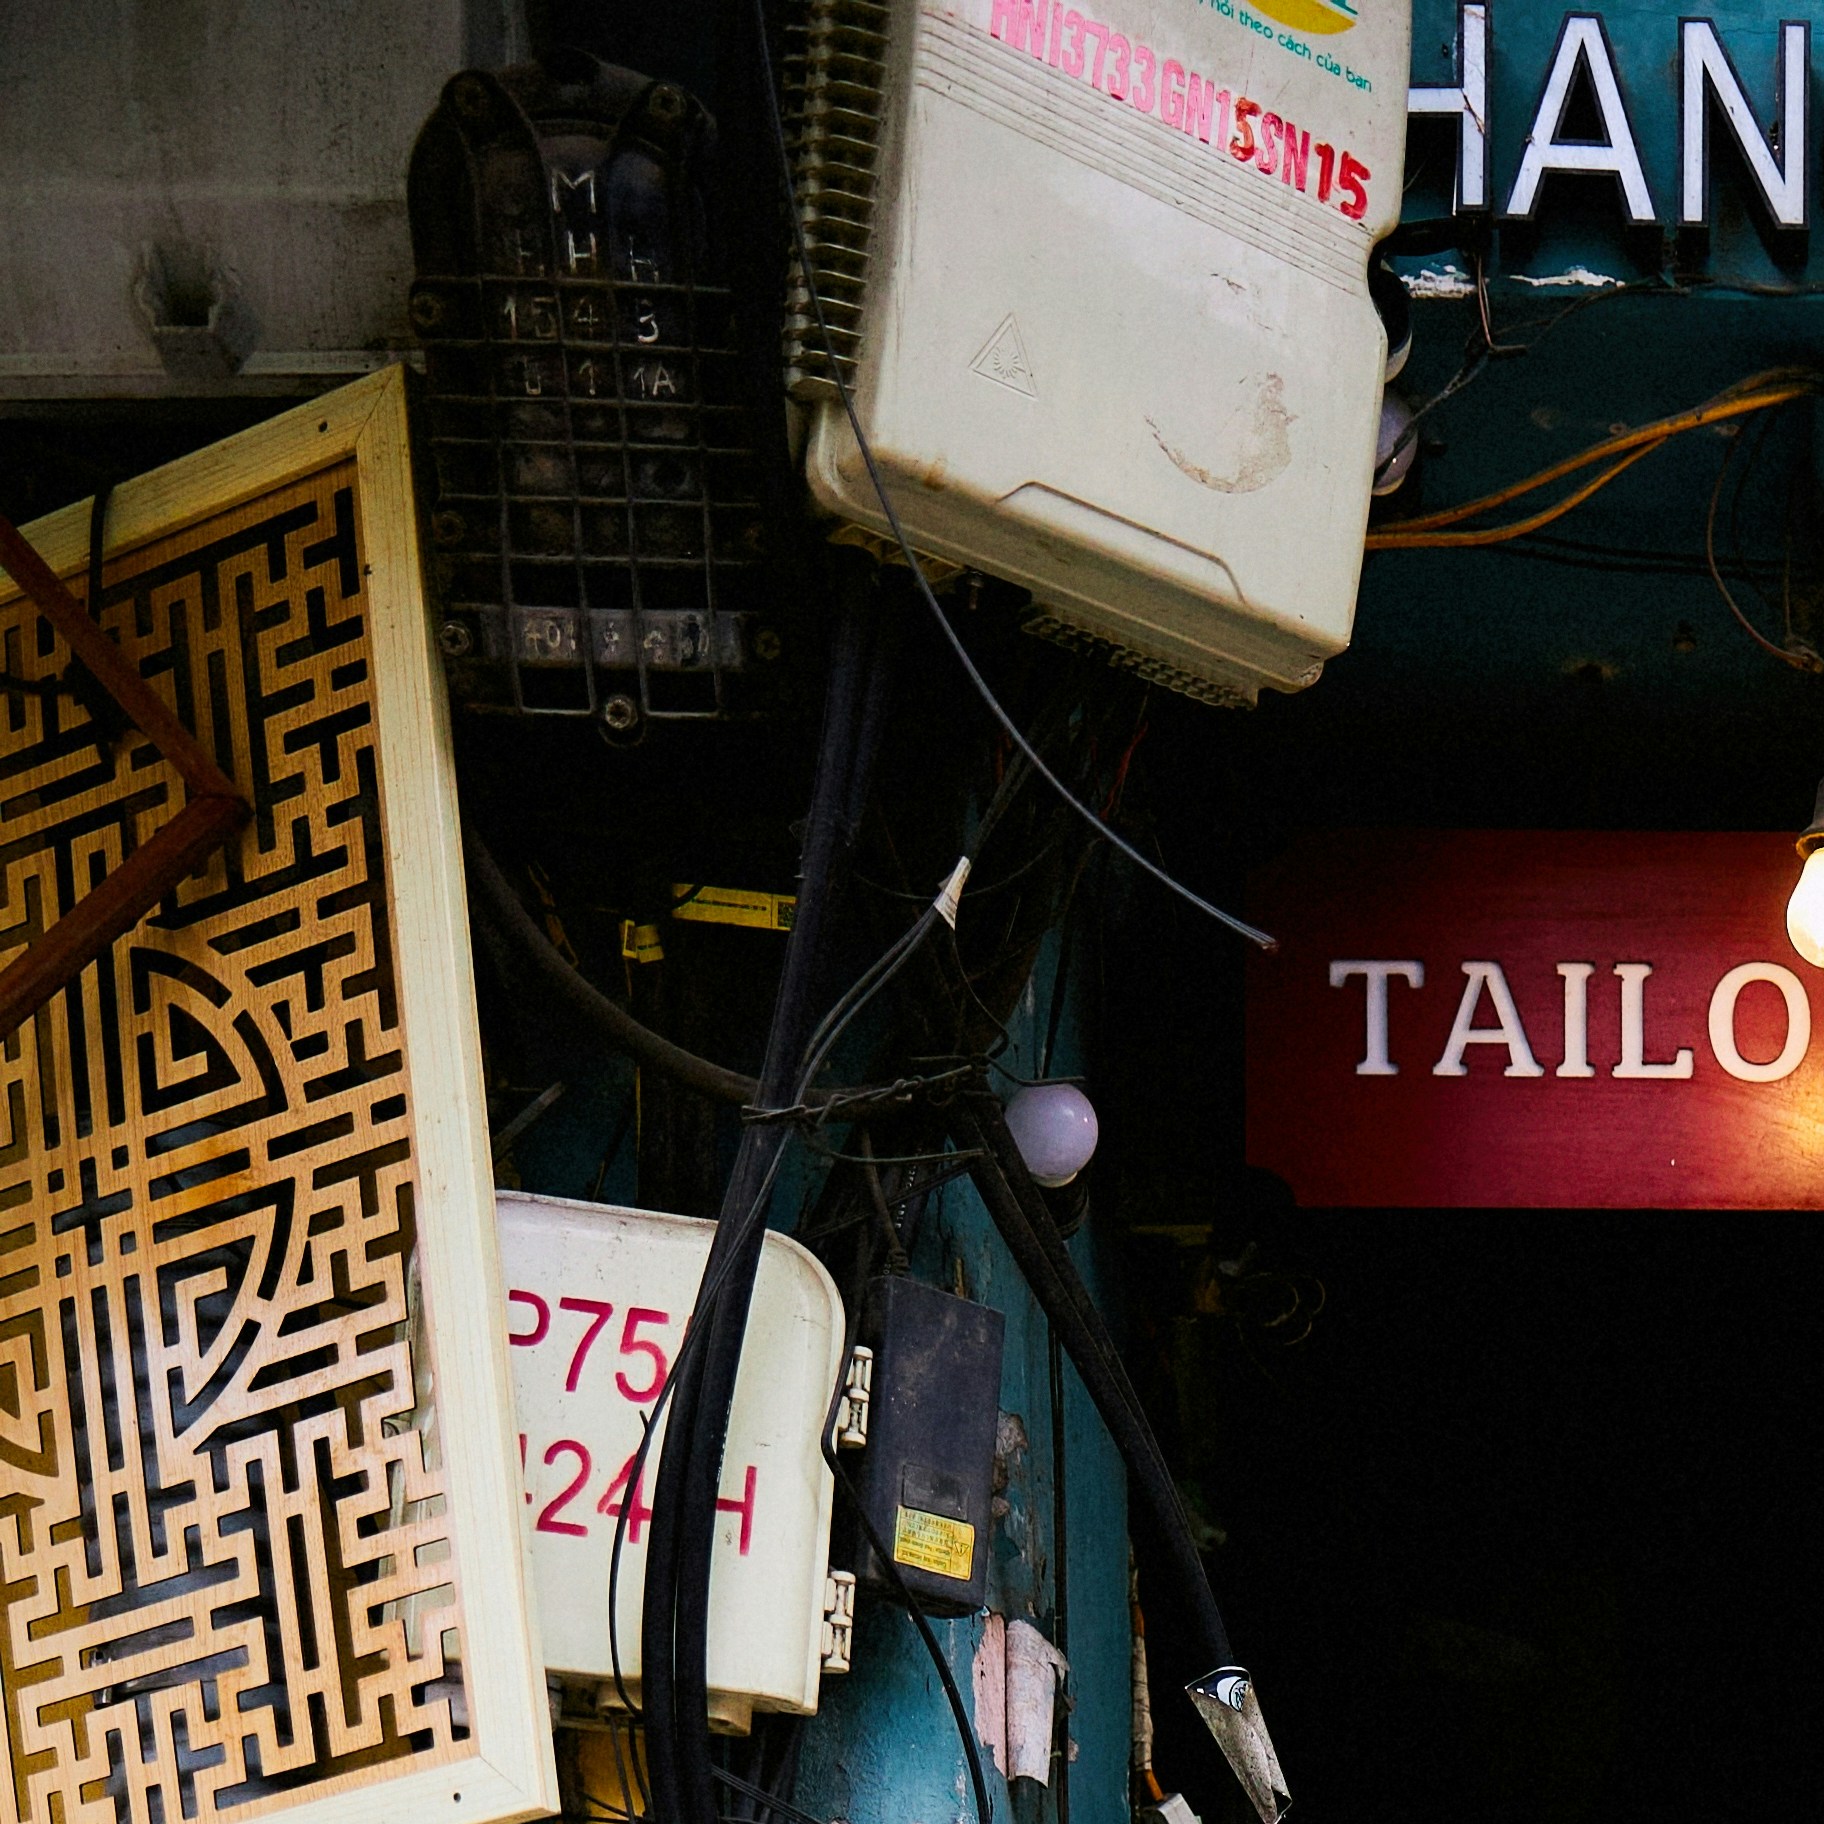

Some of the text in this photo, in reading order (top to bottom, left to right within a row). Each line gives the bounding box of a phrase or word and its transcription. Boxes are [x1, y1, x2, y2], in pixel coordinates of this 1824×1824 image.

[1238, 10, 1274, 39] theo
[1277, 33, 1312, 60] cách
[1315, 52, 1341, 76] của
[1345, 66, 1372, 93] bạn
